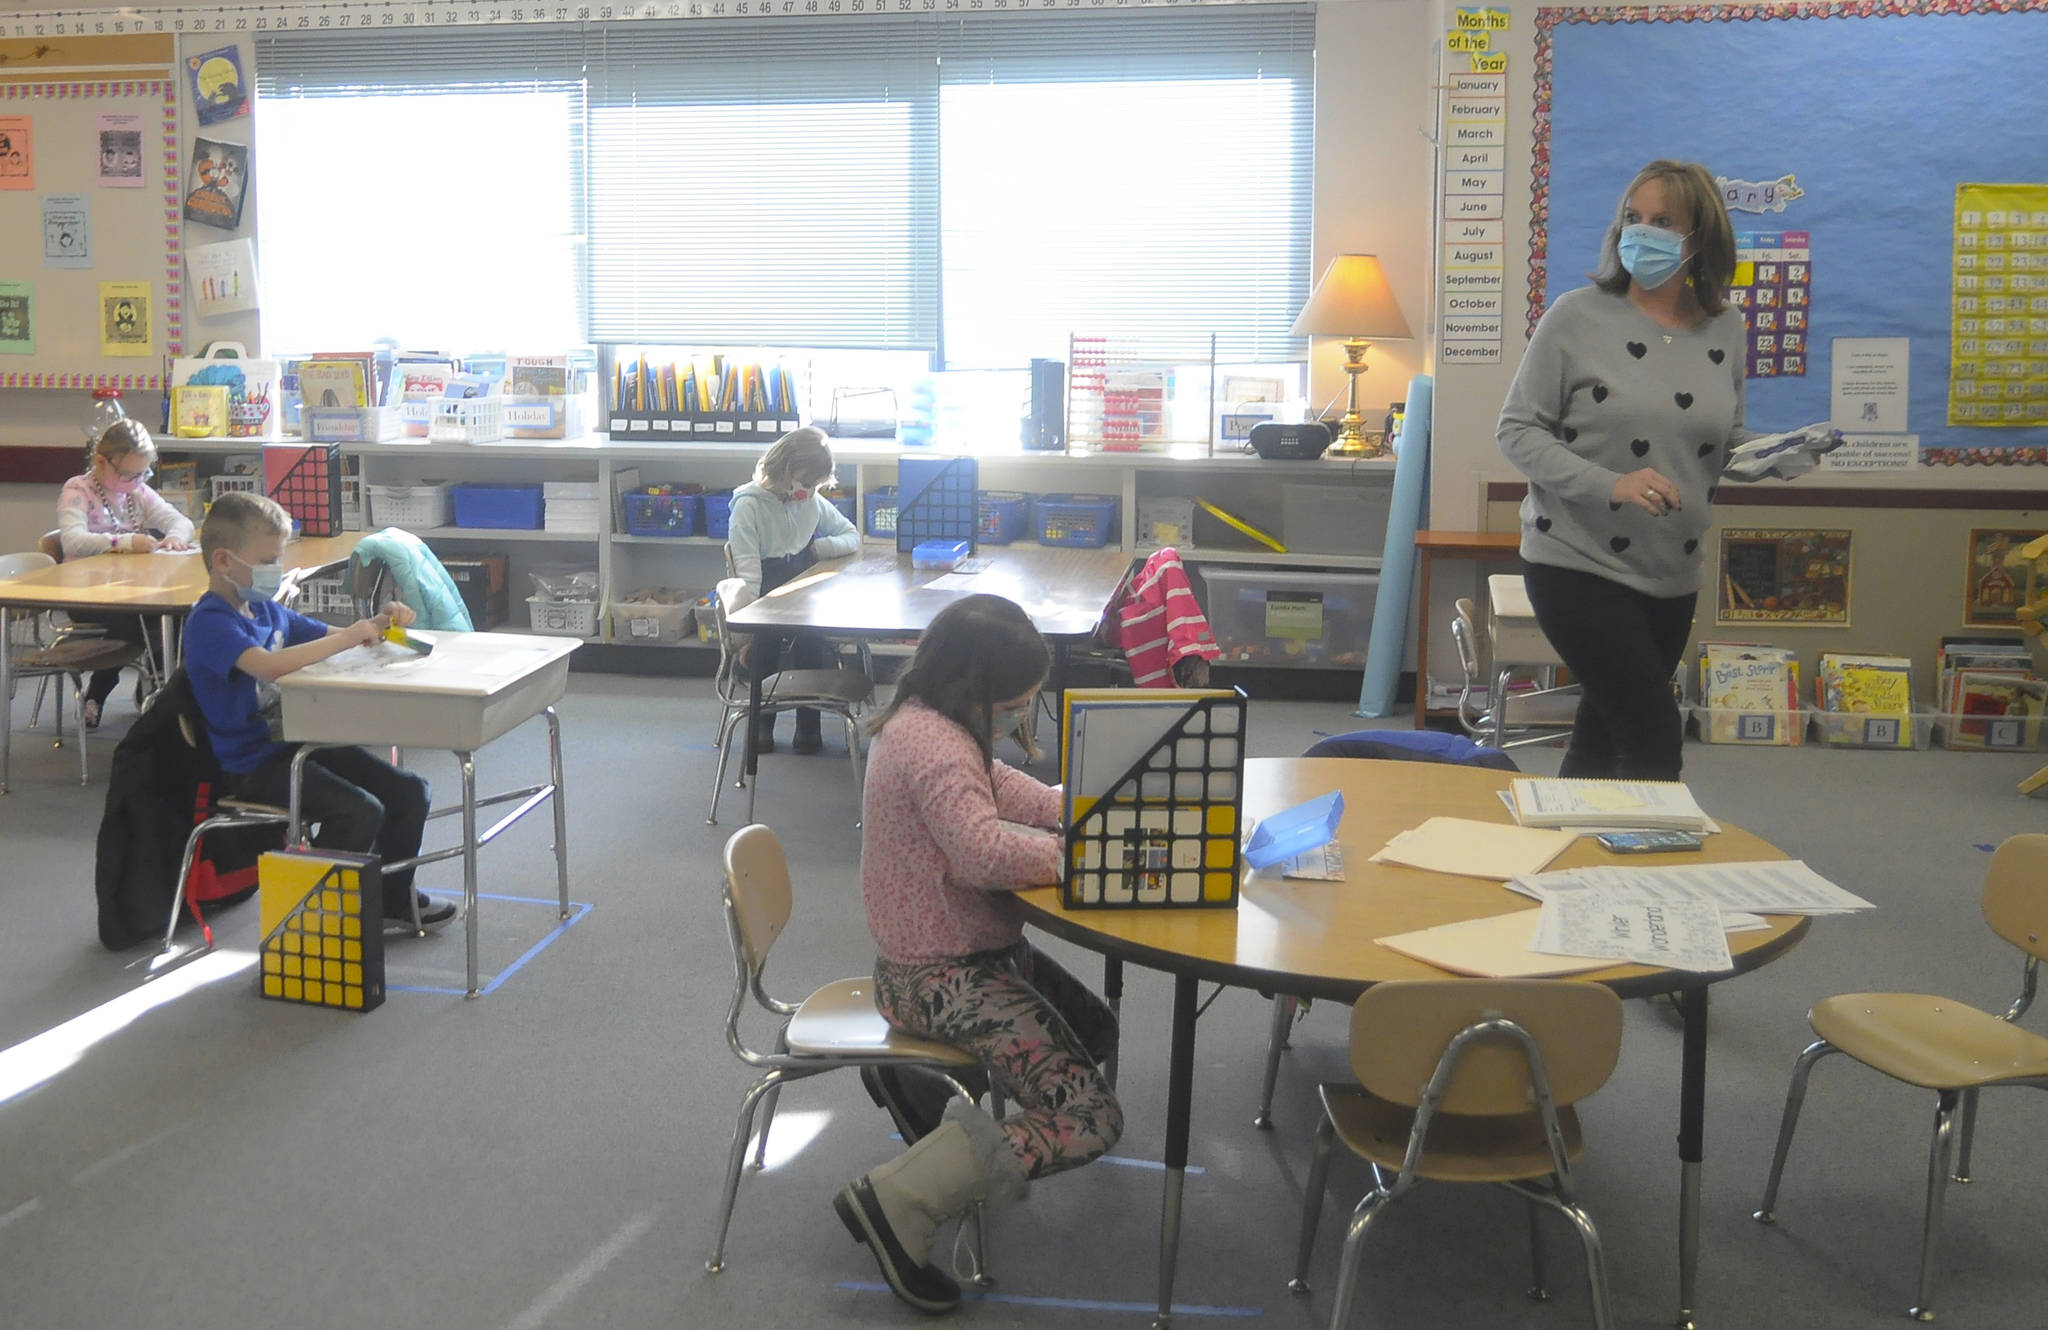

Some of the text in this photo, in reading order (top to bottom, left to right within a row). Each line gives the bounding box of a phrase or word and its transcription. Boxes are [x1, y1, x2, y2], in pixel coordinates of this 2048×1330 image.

[16, 26, 24, 35] 11
[35, 25, 44, 34] 12
[56, 24, 64, 34] 13
[76, 24, 84, 33] 14
[96, 23, 104, 32] 15
[115, 22, 124, 32] 16
[135, 21, 142, 30] 17
[154, 20, 163, 30] 18
[174, 20, 183, 30] 19
[194, 20, 205, 30] 20
[216, 20, 225, 30] 21
[236, 19, 246, 29] 22
[256, 18, 266, 28] 23
[277, 18, 287, 27] 24
[298, 17, 309, 27] 25
[320, 16, 330, 26] 26
[340, 16, 350, 26] 27
[361, 15, 371, 25] 28
[383, 14, 393, 24] 29
[403, 14, 414, 24] 30
[425, 13, 434, 23] 31
[446, 12, 456, 22] 32
[468, 11, 479, 21] 33
[489, 11, 500, 21] 34
[512, 10, 523, 20] 35
[533, 9, 544, 19] 36
[556, 8, 567, 19] 37
[578, 8, 589, 18] 38
[601, 8, 611, 17] 39
[623, 7, 634, 17] 40
[645, 6, 655, 16] 41
[668, 5, 679, 15] 42
[690, 5, 702, 15] 43
[713, 4, 724, 14] 44
[736, 3, 748, 13] 45
[759, 2, 771, 13] 46
[783, 2, 794, 13] 47
[806, 2, 817, 12] 48
[829, 1, 840, 11] 49
[852, 0, 864, 11] 50
[876, 0, 886, 10] 51
[900, 0, 911, 10] 52
[923, 0, 935, 9] 53
[947, 0, 958, 9] 54
[971, 0, 982, 8] 55
[1458, 14, 1506, 28] Months
[1448, 37, 1486, 48] of the
[1473, 58, 1504, 70] Year
[1457, 81, 1498, 91] January
[1452, 105, 1500, 116] February
[1458, 129, 1492, 139] March
[1462, 153, 1488, 165] April
[1462, 178, 1486, 188] May
[1460, 202, 1487, 211] June
[1969, 213, 1973, 225] 1
[1993, 213, 1999, 224] 2
[1462, 227, 1485, 237] July
[1962, 236, 1973, 247] 11
[2015, 236, 2027, 247] 13
[1455, 251, 1493, 262] August
[1961, 257, 1973, 268] 21
[2015, 257, 2027, 267] 23
[1764, 268, 1800, 278] 1 2
[1446, 275, 1500, 286] September
[1961, 278, 1973, 288] 31
[1735, 291, 1799, 301] 7 8 9
[1450, 299, 1496, 308] October
[1961, 298, 1973, 309] 41
[1760, 313, 1799, 324] 15 16
[1446, 323, 1499, 332] November
[1963, 320, 1975, 330] 51
[1760, 336, 1797, 347] 22 23
[1962, 342, 1975, 351] 61
[1445, 347, 1499, 356] December
[517, 358, 553, 367] TOUGH
[1760, 359, 1798, 371] 29 30
[1715, 667, 1743, 685] Best
[1752, 722, 1762, 733] B
[1877, 725, 1887, 737] B
[1998, 727, 2007, 739] C
